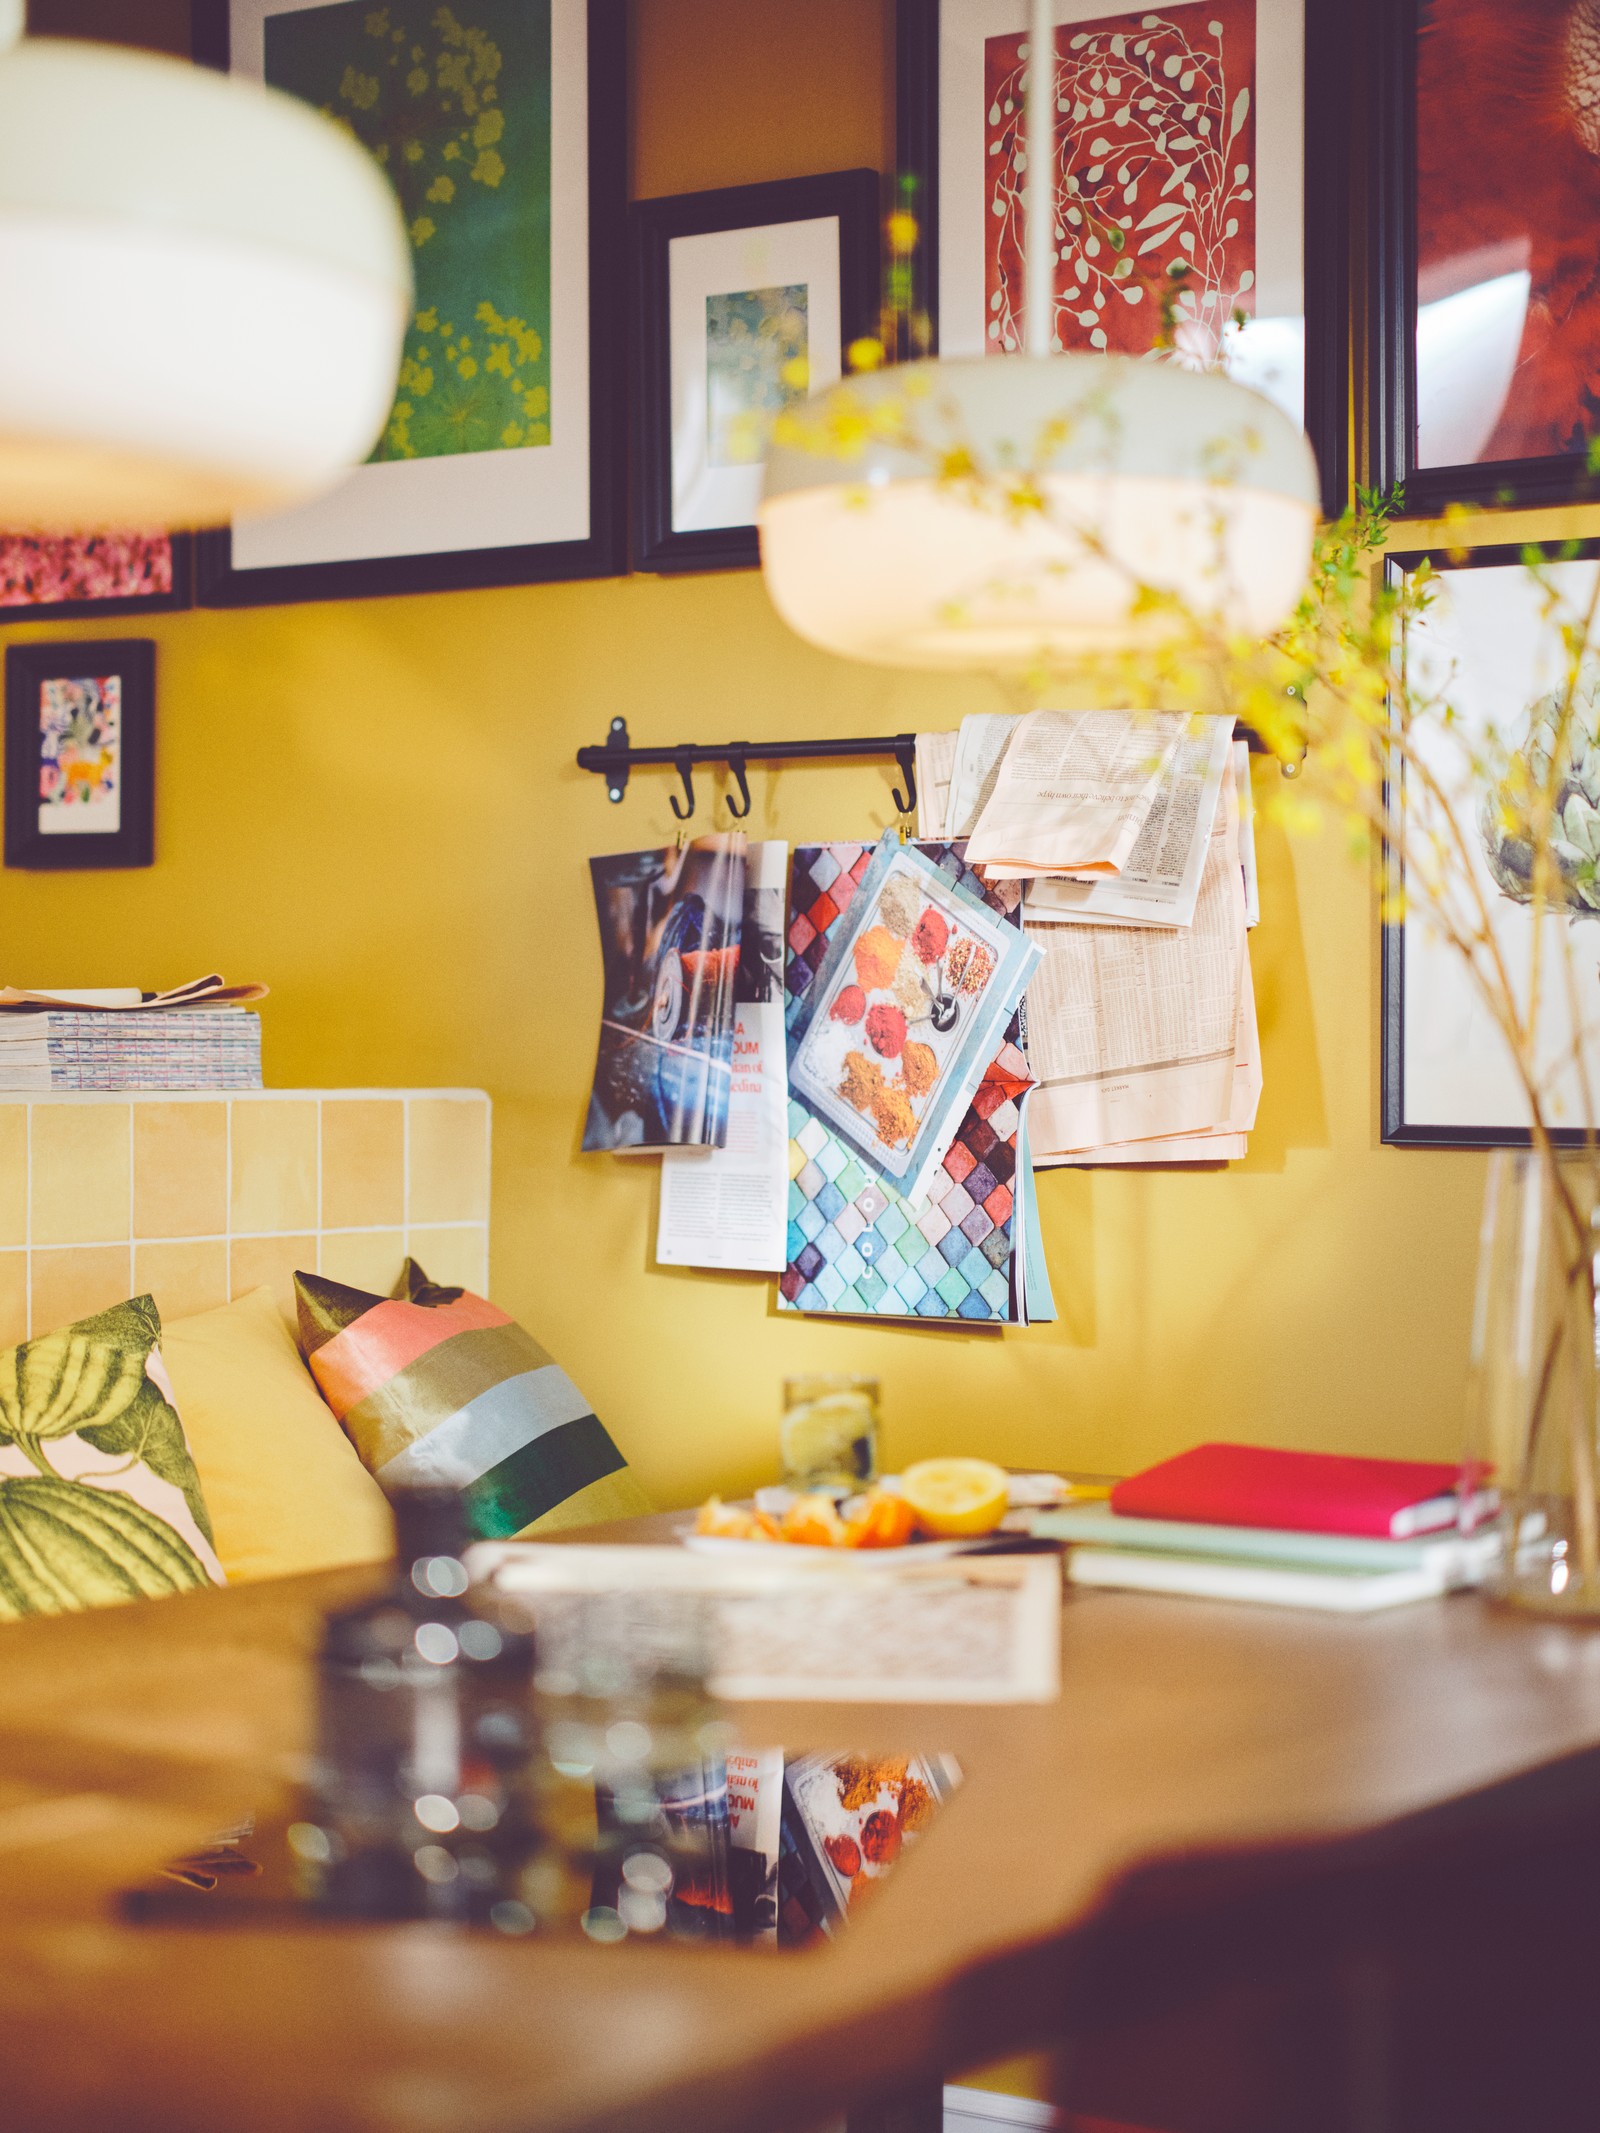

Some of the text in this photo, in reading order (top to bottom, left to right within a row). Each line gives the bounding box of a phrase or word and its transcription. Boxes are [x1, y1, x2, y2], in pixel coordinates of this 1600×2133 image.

[1037, 790, 1056, 800] hype
[1071, 792, 1088, 801] their
[1088, 793, 1116, 803] believe
